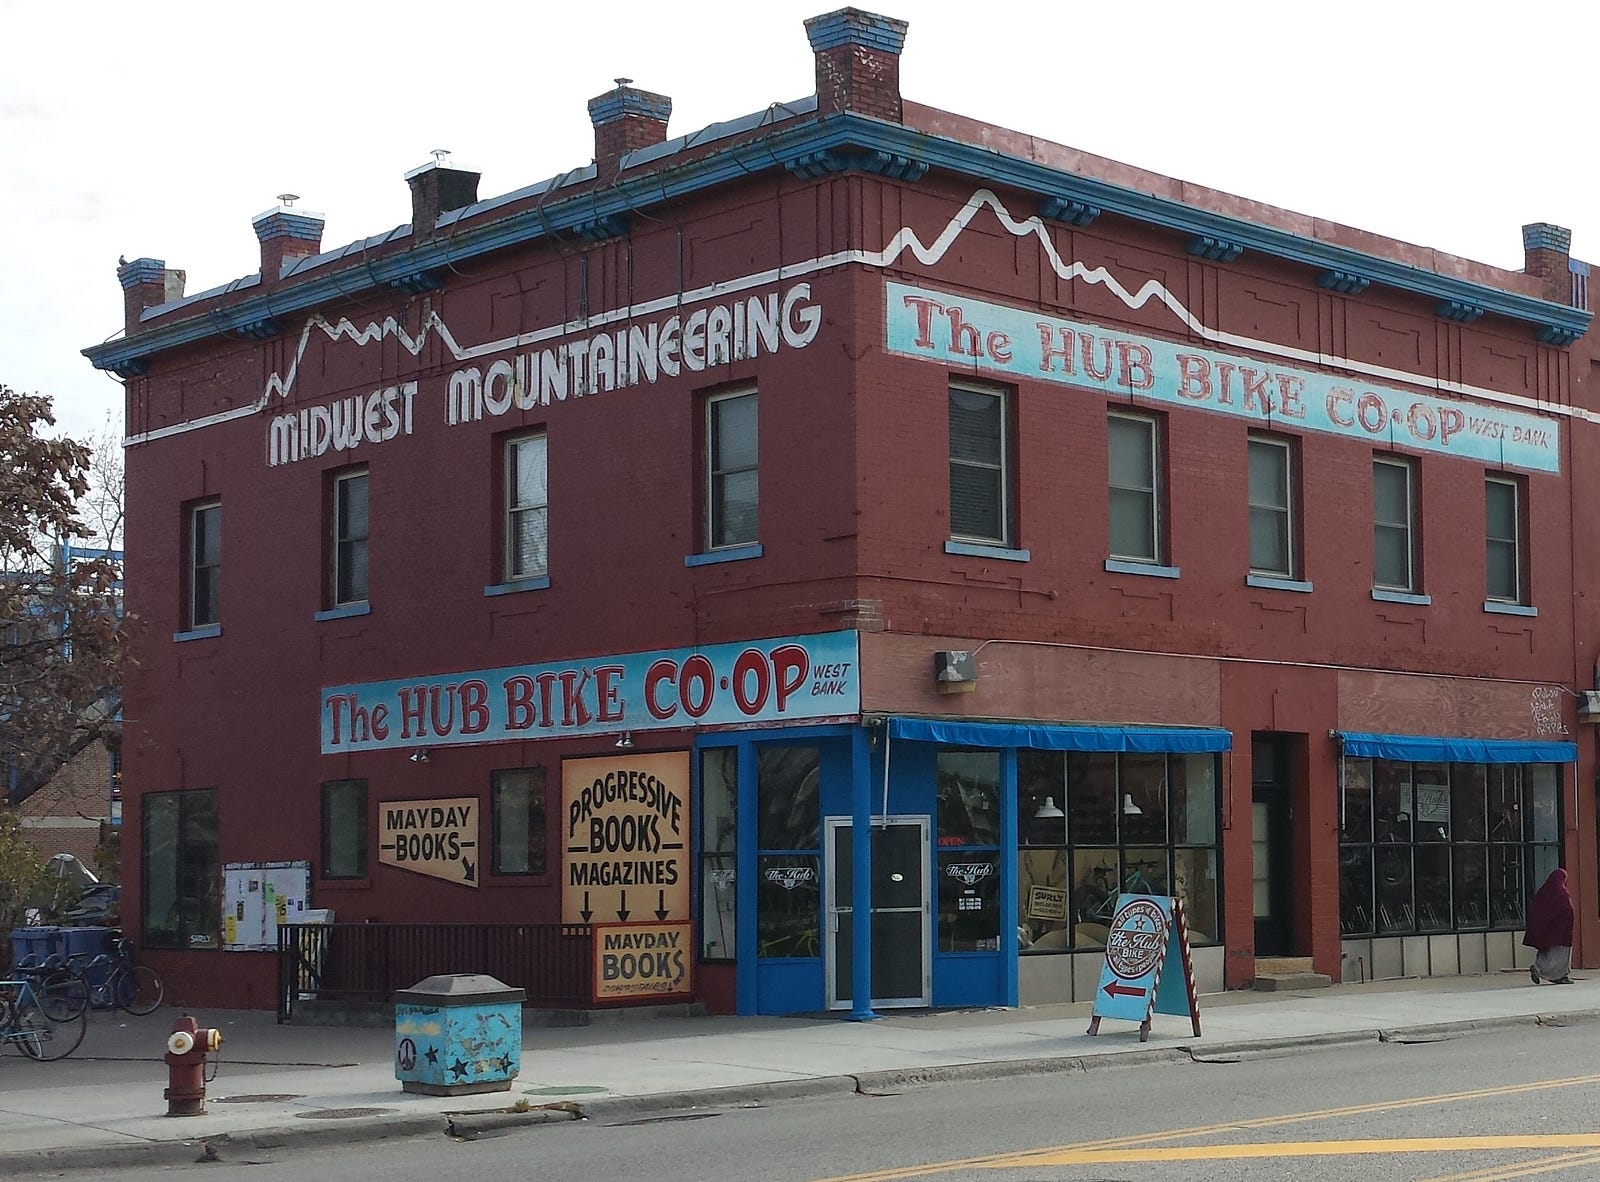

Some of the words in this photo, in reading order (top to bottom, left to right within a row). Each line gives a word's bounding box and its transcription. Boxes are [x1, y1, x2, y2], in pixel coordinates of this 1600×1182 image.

[267, 380, 418, 467] MIDWEST
[445, 282, 822, 426] MOUNTAINEERING
[903, 295, 1012, 364] The
[1036, 321, 1155, 390] HUB
[1176, 352, 1306, 419] BIKE
[1469, 415, 1509, 441] WEST
[1512, 425, 1551, 448] BANK
[812, 663, 850, 679] WEST
[811, 680, 848, 696] BANK
[325, 693, 390, 744] The
[396, 679, 490, 740] HUB
[502, 664, 625, 731] BIKE
[386, 805, 471, 831] MAYDAY
[569, 770, 683, 839] PROGRESSIVE
[396, 831, 461, 861] BOOKS
[589, 814, 660, 855] BOOKS
[570, 859, 679, 887] MAGAZINES
[1035, 891, 1064, 902] SURLY
[605, 931, 680, 950] MAYDAY
[1122, 948, 1144, 958] BIKE
[1129, 933, 1160, 949] Hub
[603, 949, 685, 986] BOOKS
